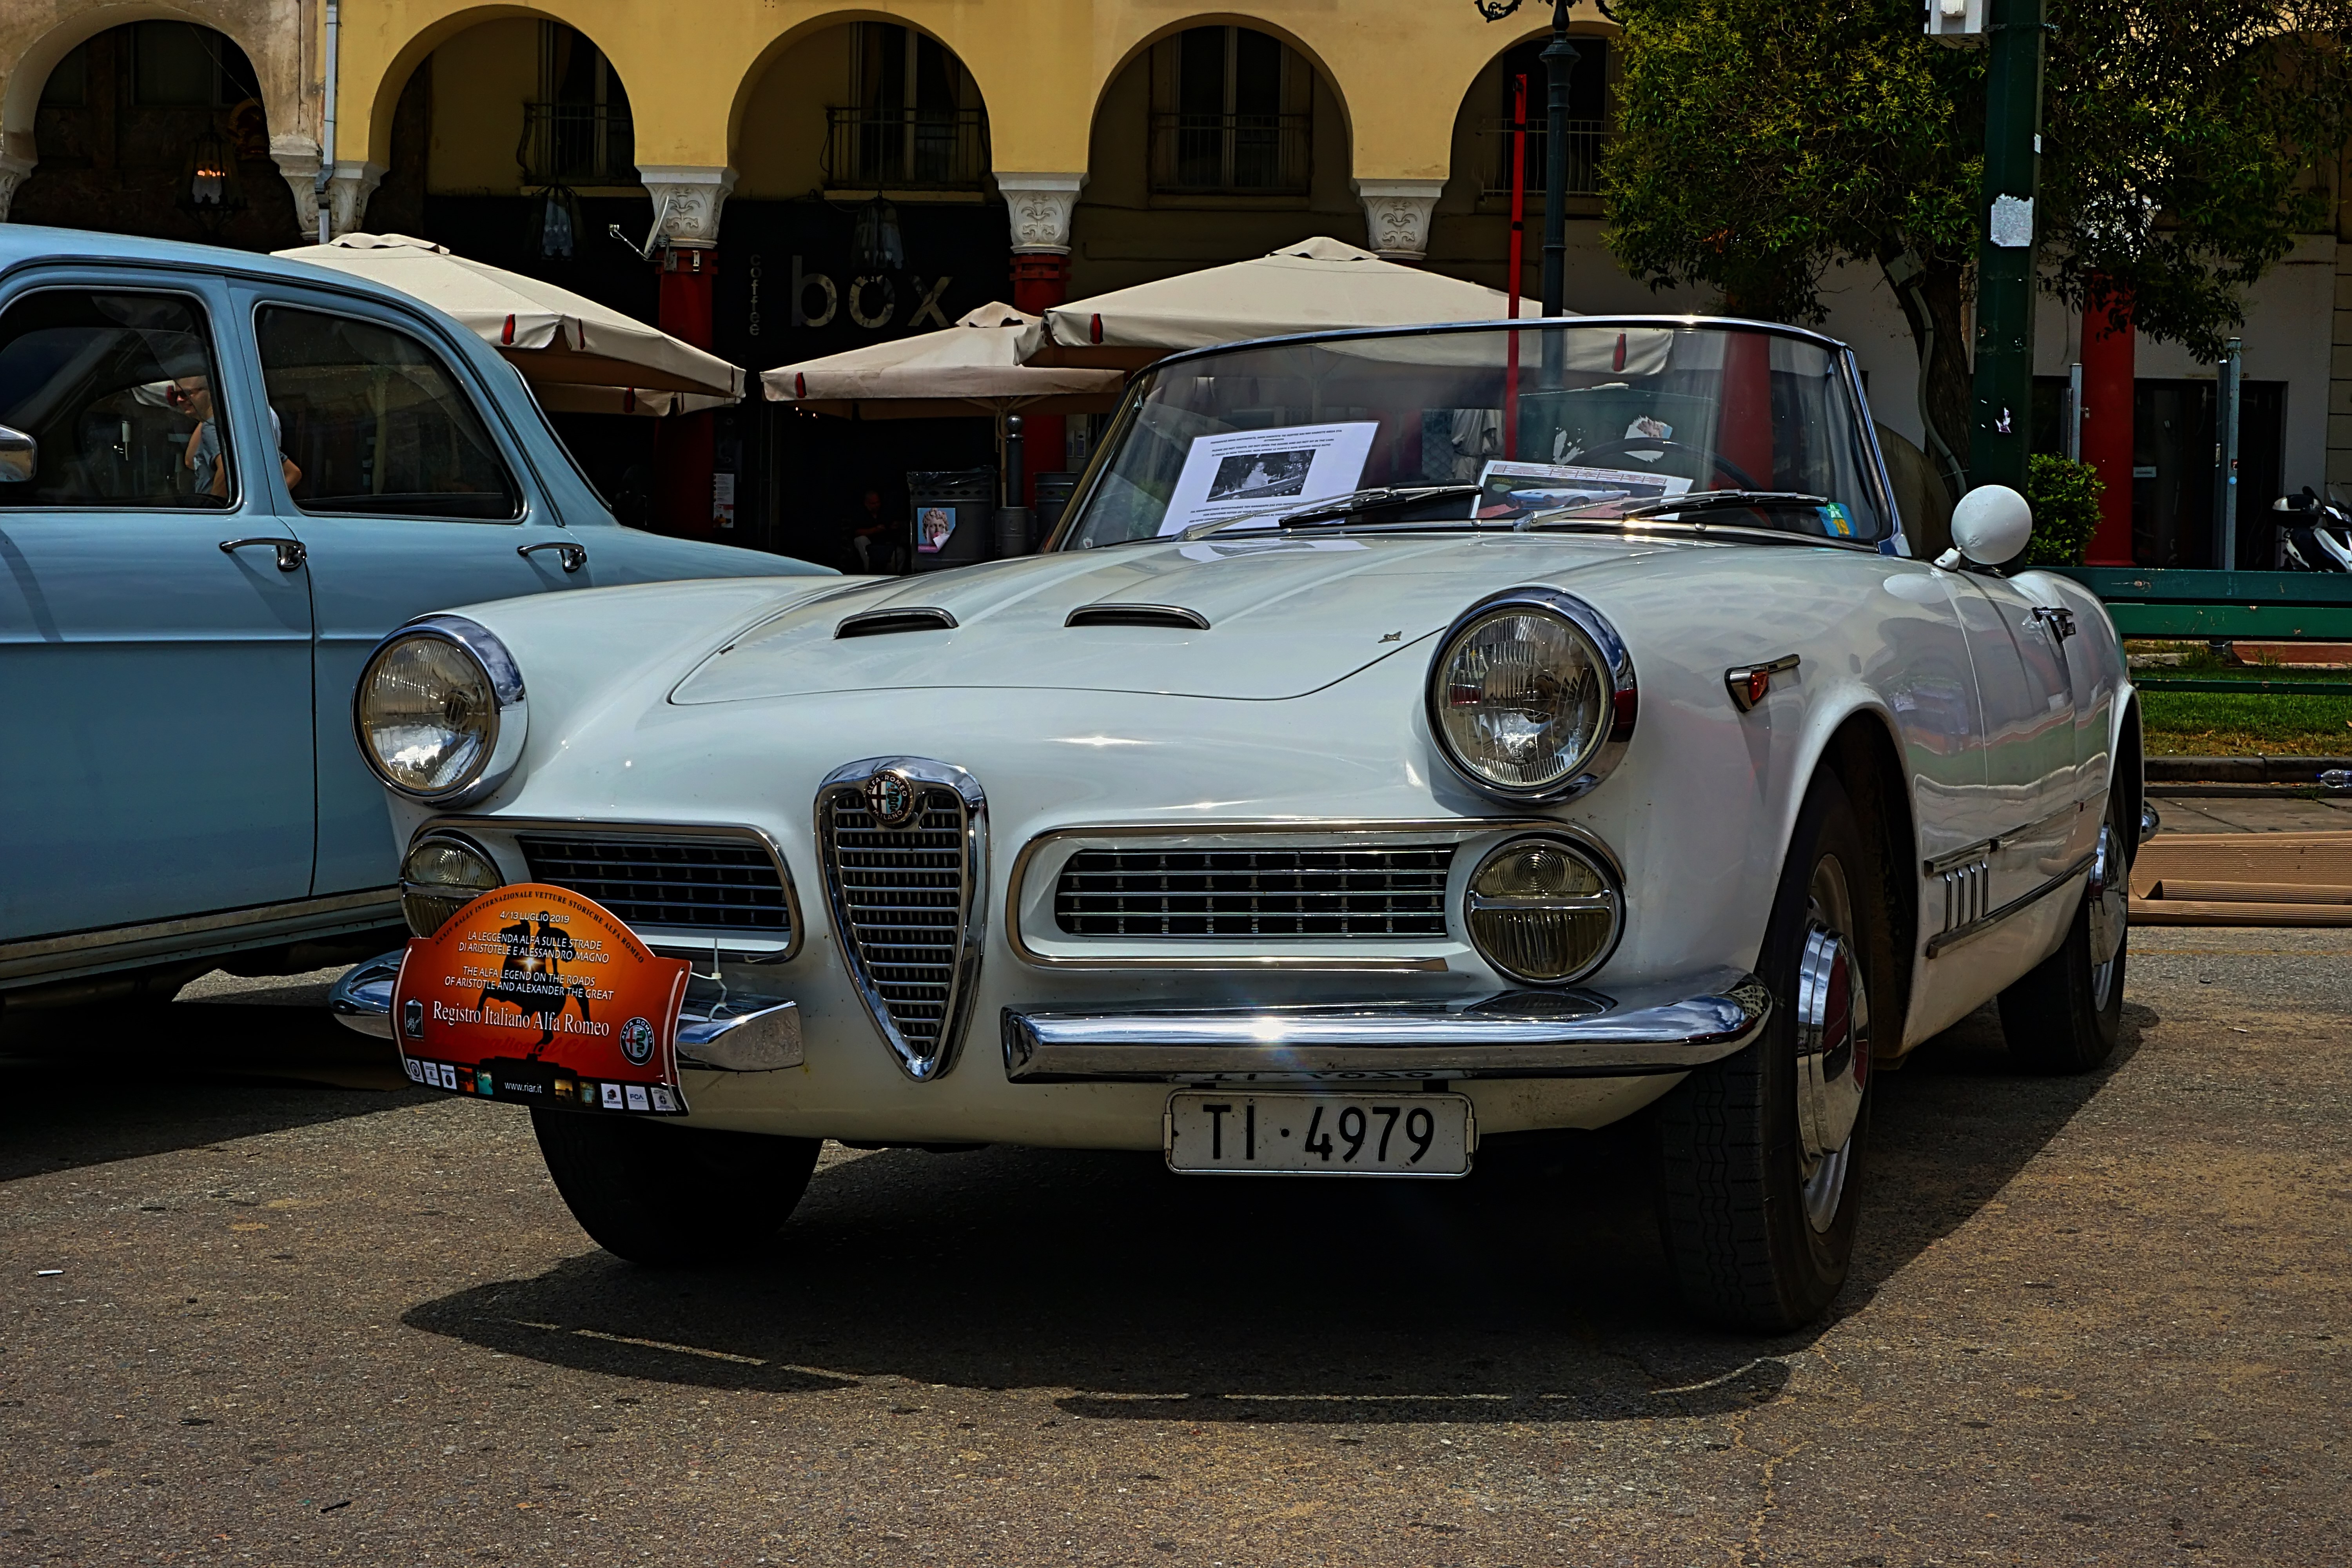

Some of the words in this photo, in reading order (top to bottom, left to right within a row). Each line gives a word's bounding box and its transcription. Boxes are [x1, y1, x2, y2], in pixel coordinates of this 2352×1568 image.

[750, 254, 762, 336] coffee
[791, 255, 953, 328] box
[867, 777, 881, 795] ALFA
[884, 775, 908, 797] ROMEO
[872, 809, 903, 820] MILANO
[454, 909, 474, 929] RALLY
[475, 891, 533, 913] INTERNAZIONALE
[535, 891, 567, 904] VETTURE
[568, 900, 604, 925] STORICHE
[604, 922, 620, 940] ALFA
[621, 936, 644, 964] ROMEO
[499, 911, 519, 920] 4/13
[519, 912, 549, 922] LUGLIO
[550, 914, 570, 924] 2019
[467, 931, 477, 940] LA
[478, 931, 519, 944] LEGGENDA
[519, 935, 540, 945] ALFA
[541, 936, 567, 947] SULLE
[568, 938, 603, 951] STRADE
[459, 942, 466, 951] DI
[467, 942, 512, 955] ARISTOTELE
[513, 946, 518, 956] E
[519, 947, 573, 960] ALESSANDRO
[574, 951, 610, 964] MAGNO
[463, 965, 478, 976] THE
[478, 967, 498, 978] ALFA
[499, 969, 532, 981] LEGEND
[533, 972, 546, 982] ON
[548, 973, 565, 984] THE
[566, 975, 596, 986] ROADS
[444, 976, 456, 986] OF
[455, 977, 496, 990] ARISTOTLE
[496, 981, 515, 991] AND
[515, 983, 565, 996] ALEXANDER
[566, 987, 584, 998] THE
[585, 989, 615, 1000] GREAT
[433, 1000, 481, 1026] Registro
[484, 1006, 530, 1029] Italiano
[533, 1011, 560, 1031] Alfa
[563, 1013, 610, 1036] Romeo
[621, 1021, 634, 1040] ALFA
[636, 1019, 653, 1044] ROMEO
[504, 1082, 542, 1093] www.riar.it
[1202, 1103, 1255, 1160] TI
[1305, 1105, 1435, 1164] 4979
